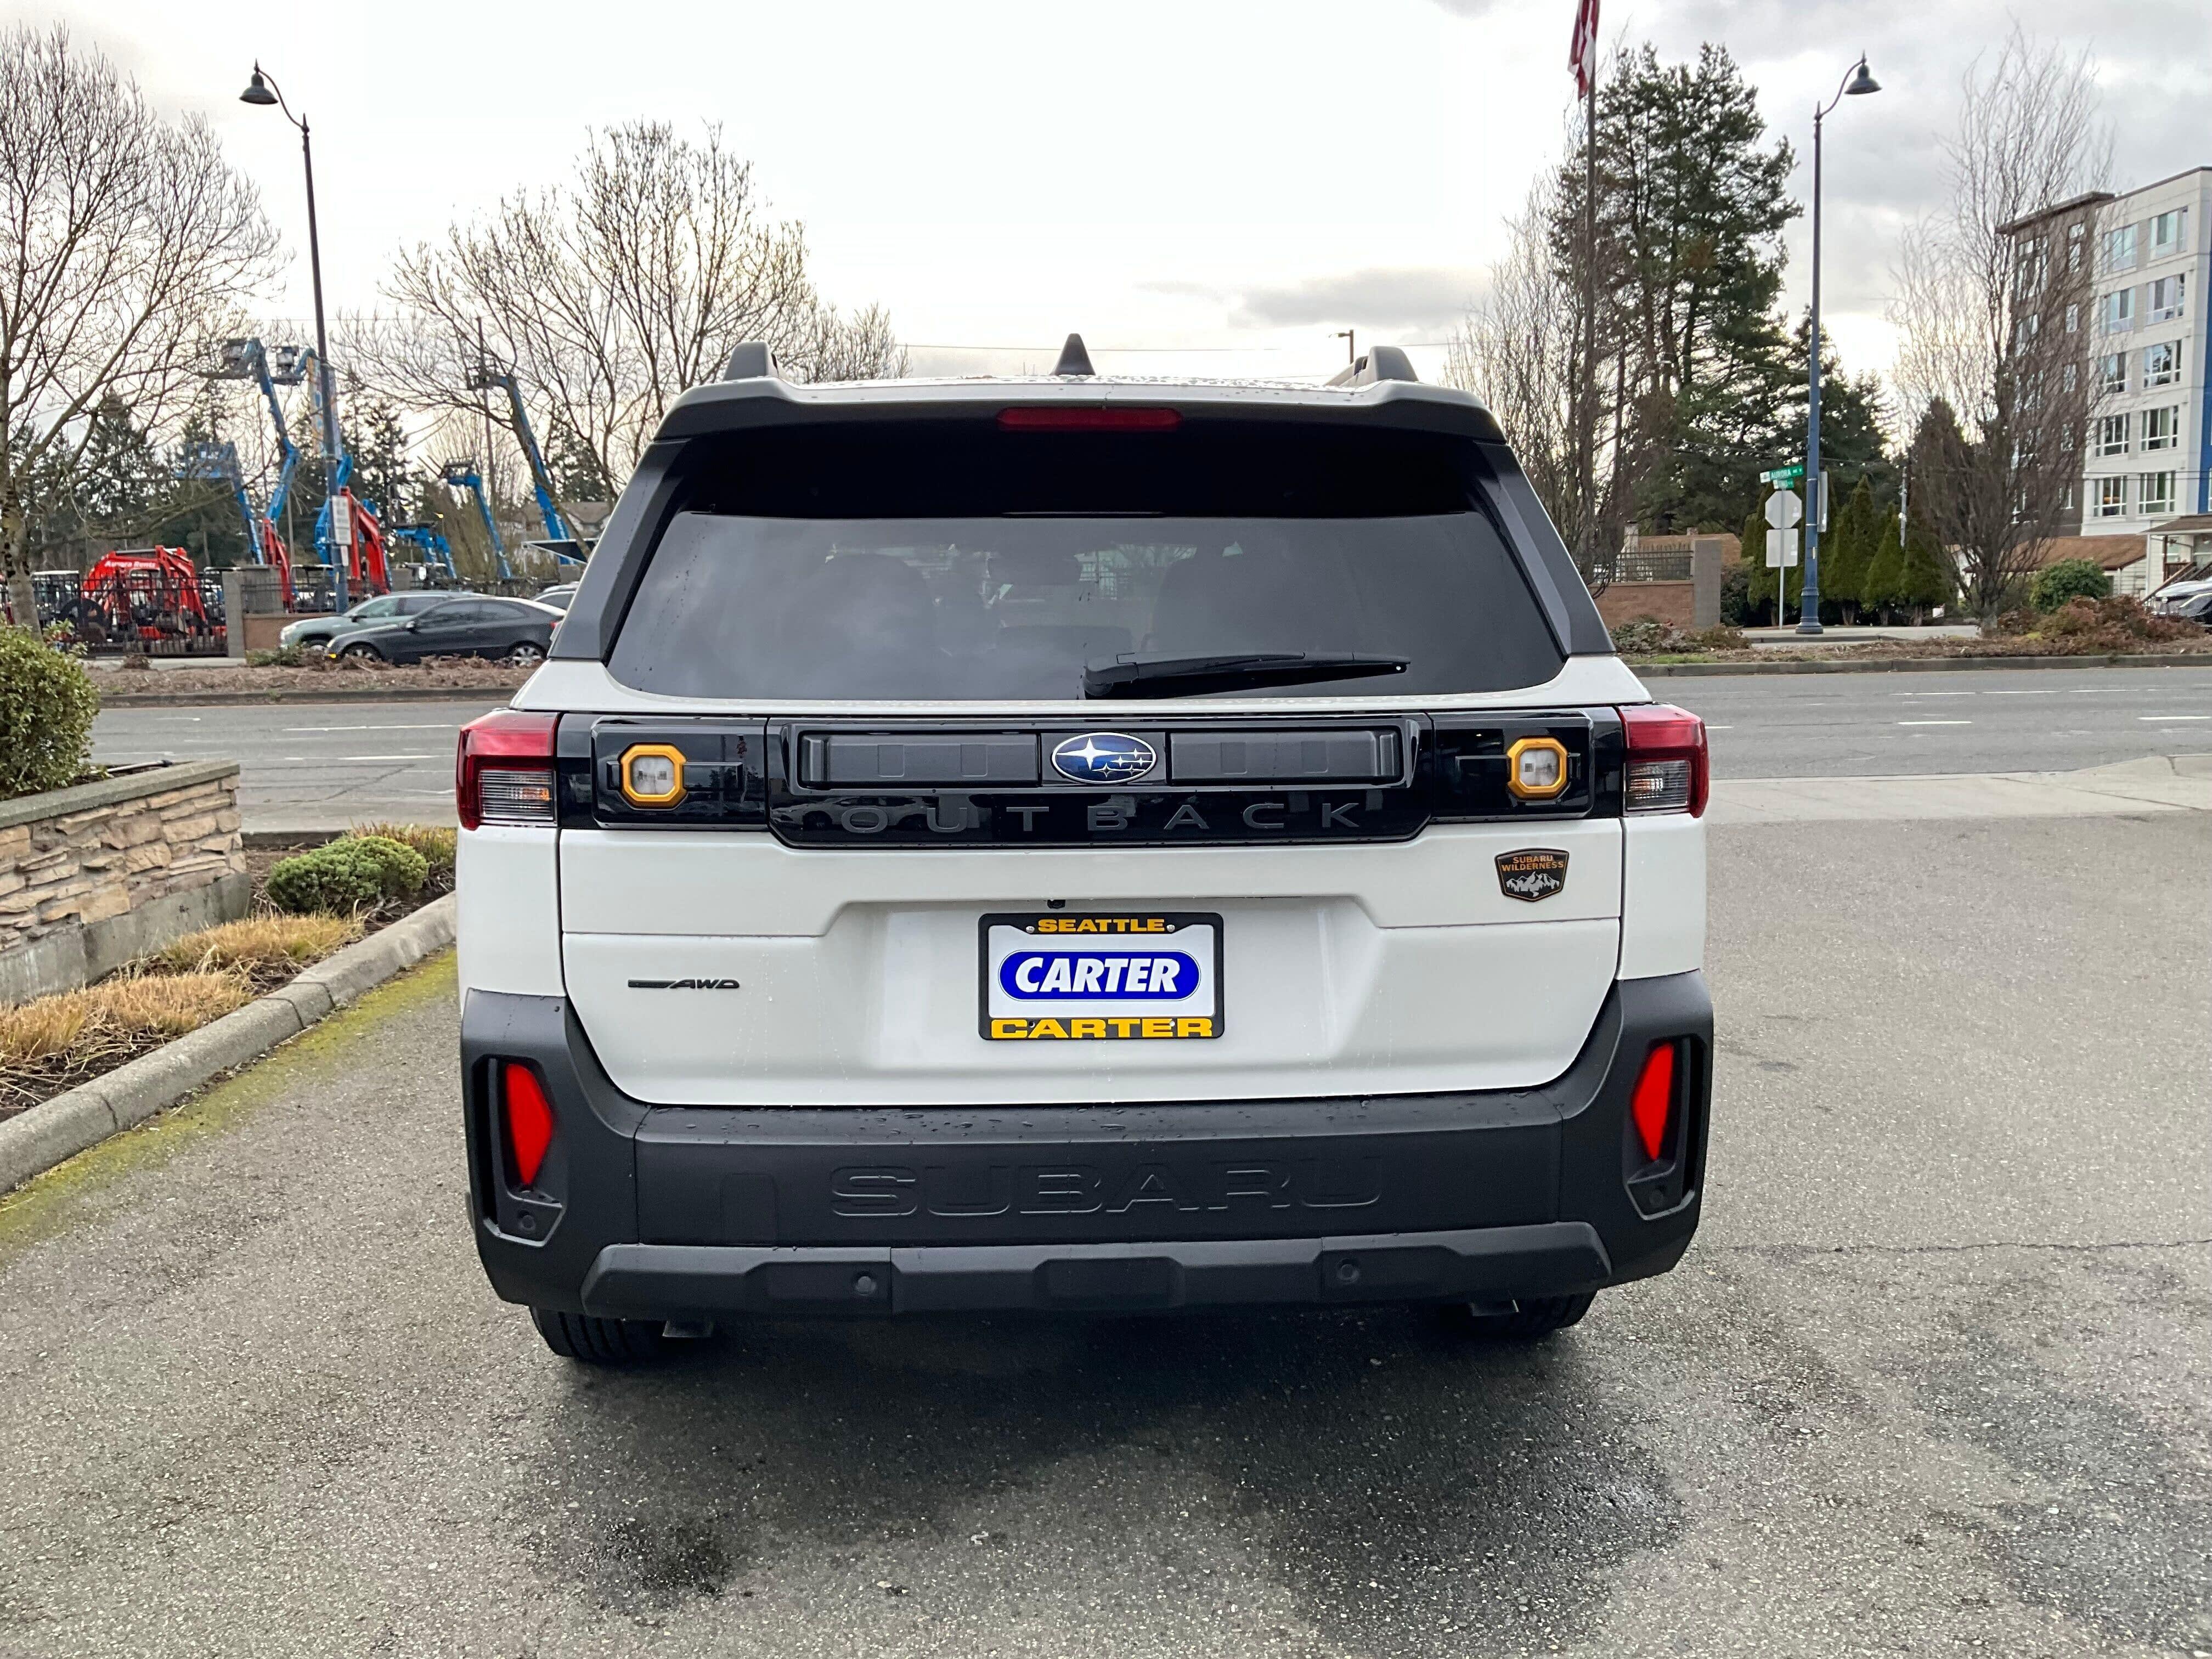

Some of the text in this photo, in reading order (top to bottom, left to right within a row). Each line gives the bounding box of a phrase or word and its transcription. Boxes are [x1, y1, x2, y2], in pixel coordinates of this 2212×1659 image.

[1771, 469, 1791, 479] AURORA
[840, 803, 1360, 833] OUTBACK
[1501, 861, 1564, 872] WILDERNESS
[1513, 855, 1553, 864] SUBARU
[1037, 918, 1165, 933] SEATTLE
[1015, 957, 1181, 993] CARTER
[669, 979, 740, 989] AWD
[990, 1018, 1213, 1039] CARTER
[829, 1156, 1383, 1217] SUBARU
